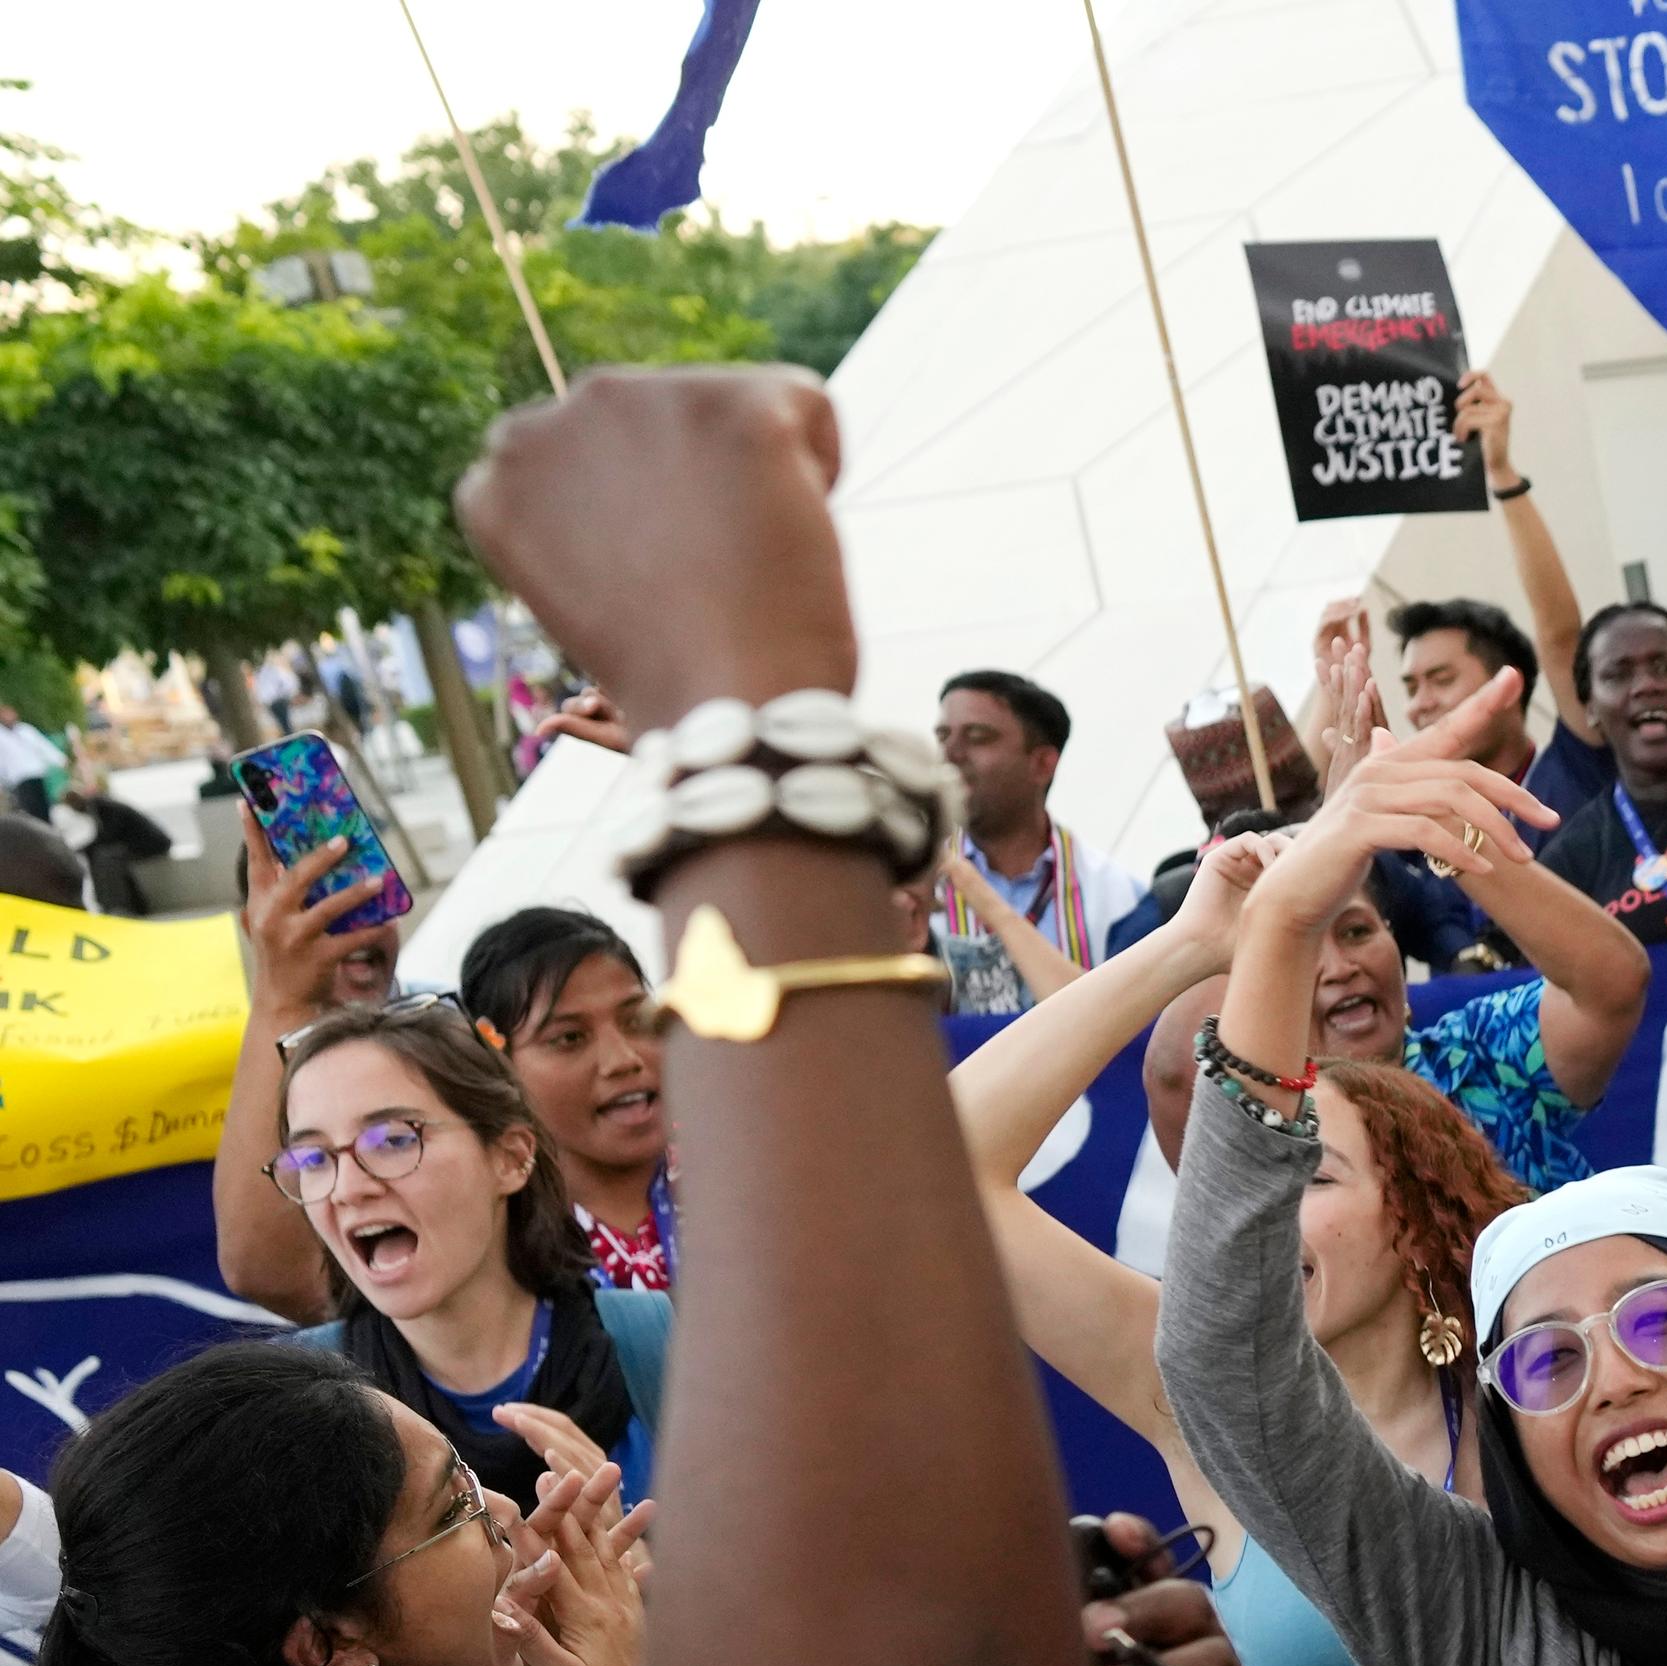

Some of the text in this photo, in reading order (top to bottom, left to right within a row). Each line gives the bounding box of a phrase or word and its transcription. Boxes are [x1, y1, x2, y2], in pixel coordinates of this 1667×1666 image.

[1315, 375, 1444, 419] DEMAND
[1313, 405, 1447, 447] CLIMATE
[1312, 433, 1463, 486] JUSTICE
